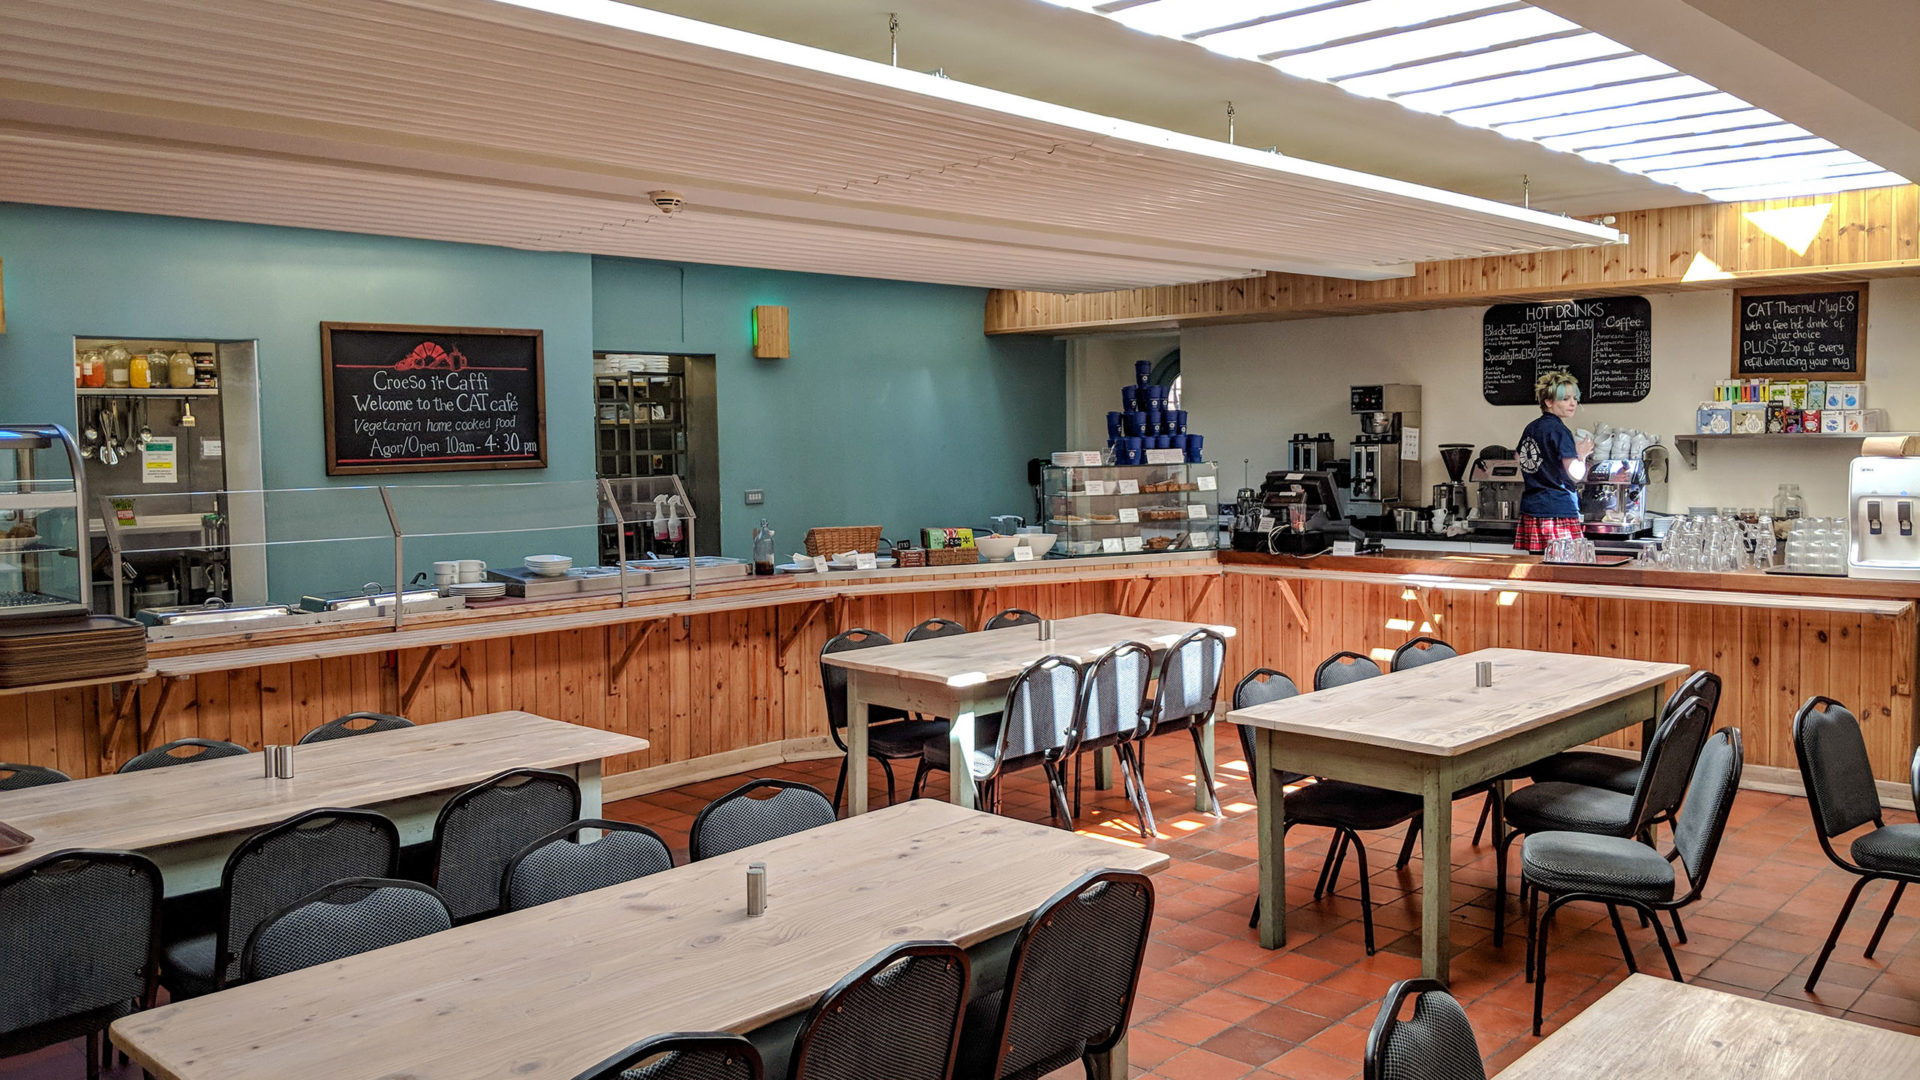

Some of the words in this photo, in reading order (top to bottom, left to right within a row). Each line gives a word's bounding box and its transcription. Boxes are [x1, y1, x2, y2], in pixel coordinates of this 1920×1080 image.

[1526, 306, 1553, 321] HOT
[1556, 302, 1604, 319] DRINKS
[1747, 300, 1774, 317] CAT
[1776, 300, 1816, 314] Thermal
[1818, 299, 1838, 319] Mug
[1839, 296, 1854, 312] £8
[1485, 324, 1507, 336] Black
[1507, 324, 1521, 334] Tea
[1539, 321, 1561, 332] Herbal
[1562, 320, 1575, 330] Tea
[1606, 316, 1640, 330] Coffee
[1772, 320, 1788, 331] free
[1790, 317, 1804, 329] hot
[1807, 318, 1828, 328] drink
[1834, 317, 1845, 331] of
[1772, 331, 1790, 344] your
[1793, 330, 1820, 338] choice
[1509, 348, 1521, 360] Tea
[1744, 340, 1776, 354] PLUS
[1781, 341, 1800, 356] 25p
[1803, 342, 1816, 354] off
[1819, 343, 1844, 355] every
[1765, 356, 1785, 366] when
[1809, 358, 1828, 370] your
[1832, 357, 1849, 369] mug
[446, 372, 488, 391] Caffi
[352, 395, 413, 412] Welcome
[418, 398, 430, 412] to
[435, 398, 454, 412] the
[456, 393, 488, 412] CAT
[490, 392, 519, 412] café
[354, 418, 421, 436] Vegetarian
[427, 418, 452, 432] home
[455, 417, 490, 430] cooked
[494, 415, 516, 431] food
[524, 442, 537, 455] pm
